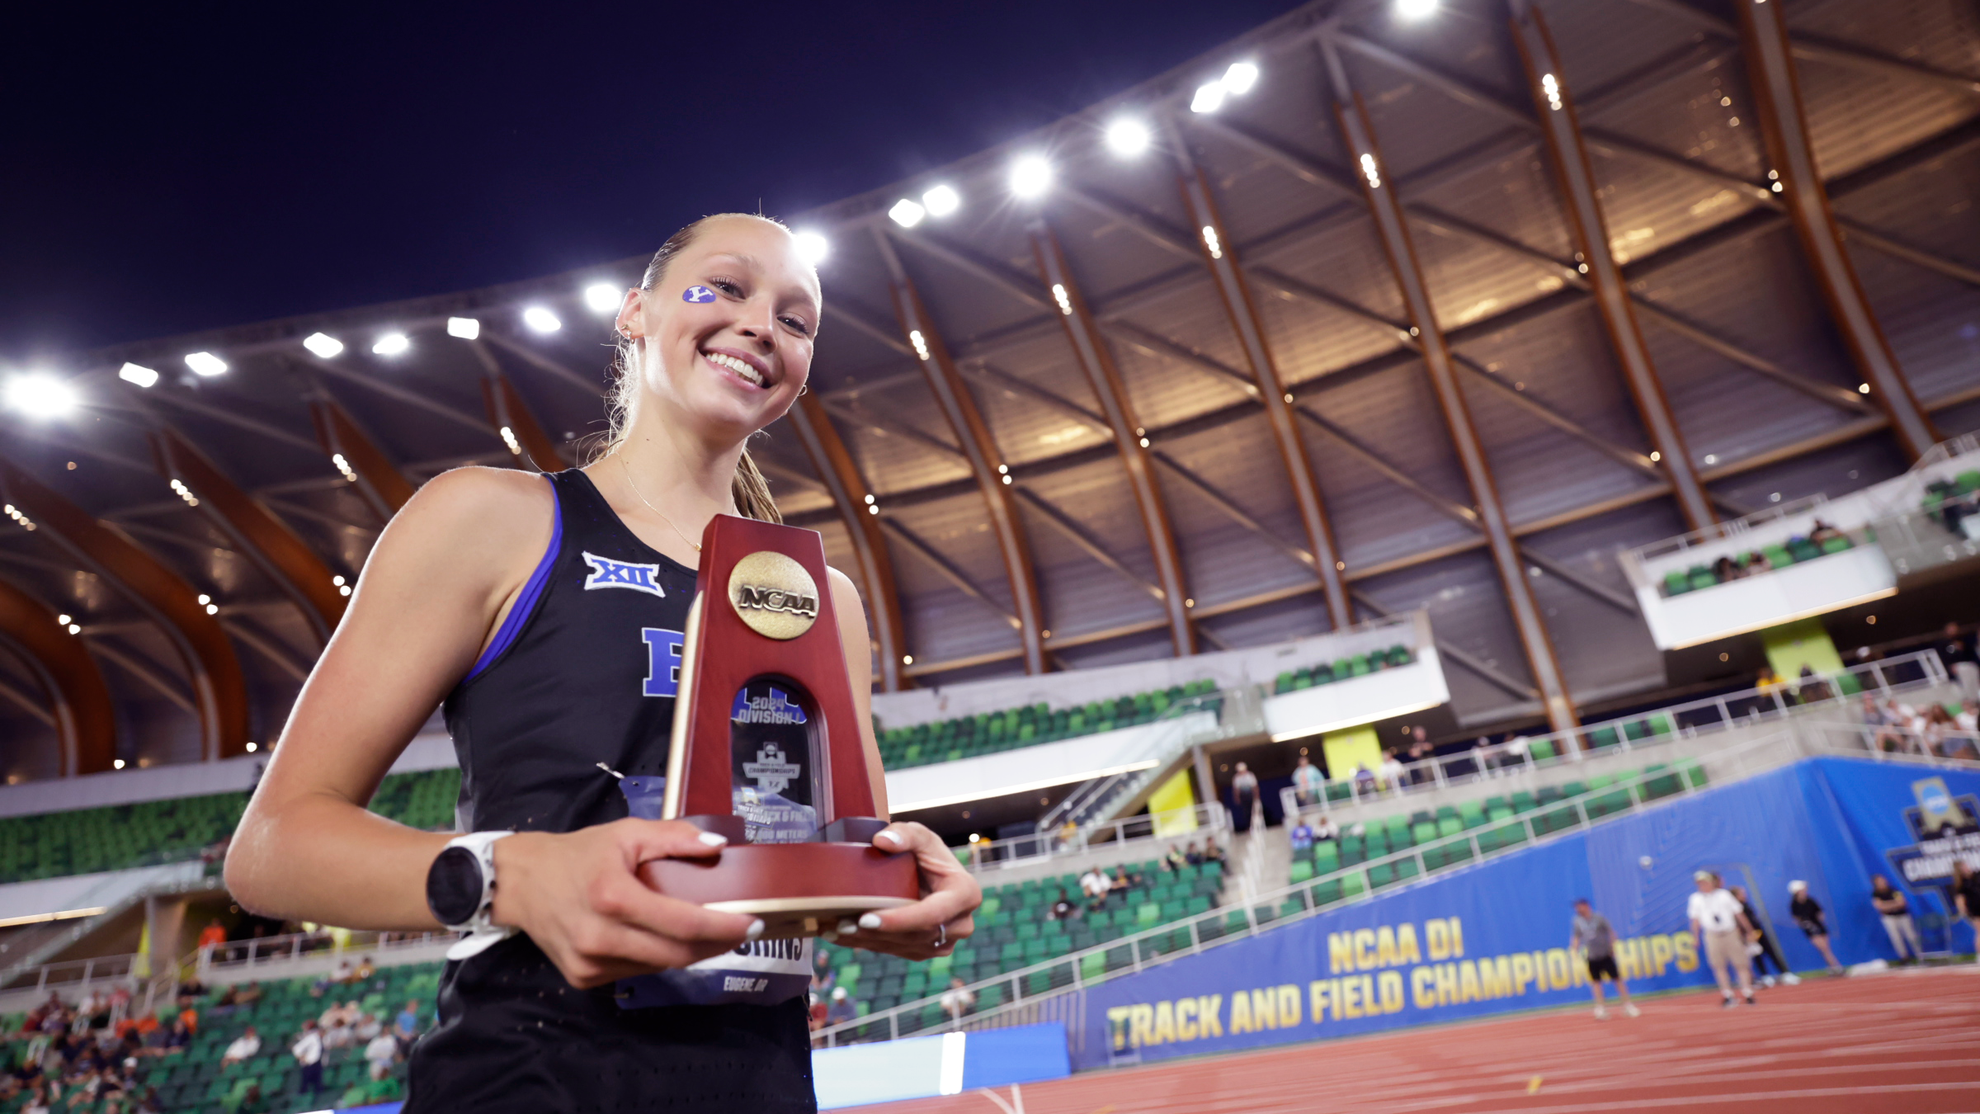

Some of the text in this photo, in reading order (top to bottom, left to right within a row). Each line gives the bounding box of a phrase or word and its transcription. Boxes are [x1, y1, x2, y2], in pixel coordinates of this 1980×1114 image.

[688, 286, 714, 302] Y
[739, 585, 816, 618] NCAA
[752, 697, 785, 711] 2024
[738, 709, 793, 725] DIVISION
[1328, 915, 1465, 974] NCAA DI
[1106, 930, 1699, 1050] TRACK AND FIELD CHAMPIONHIPS
